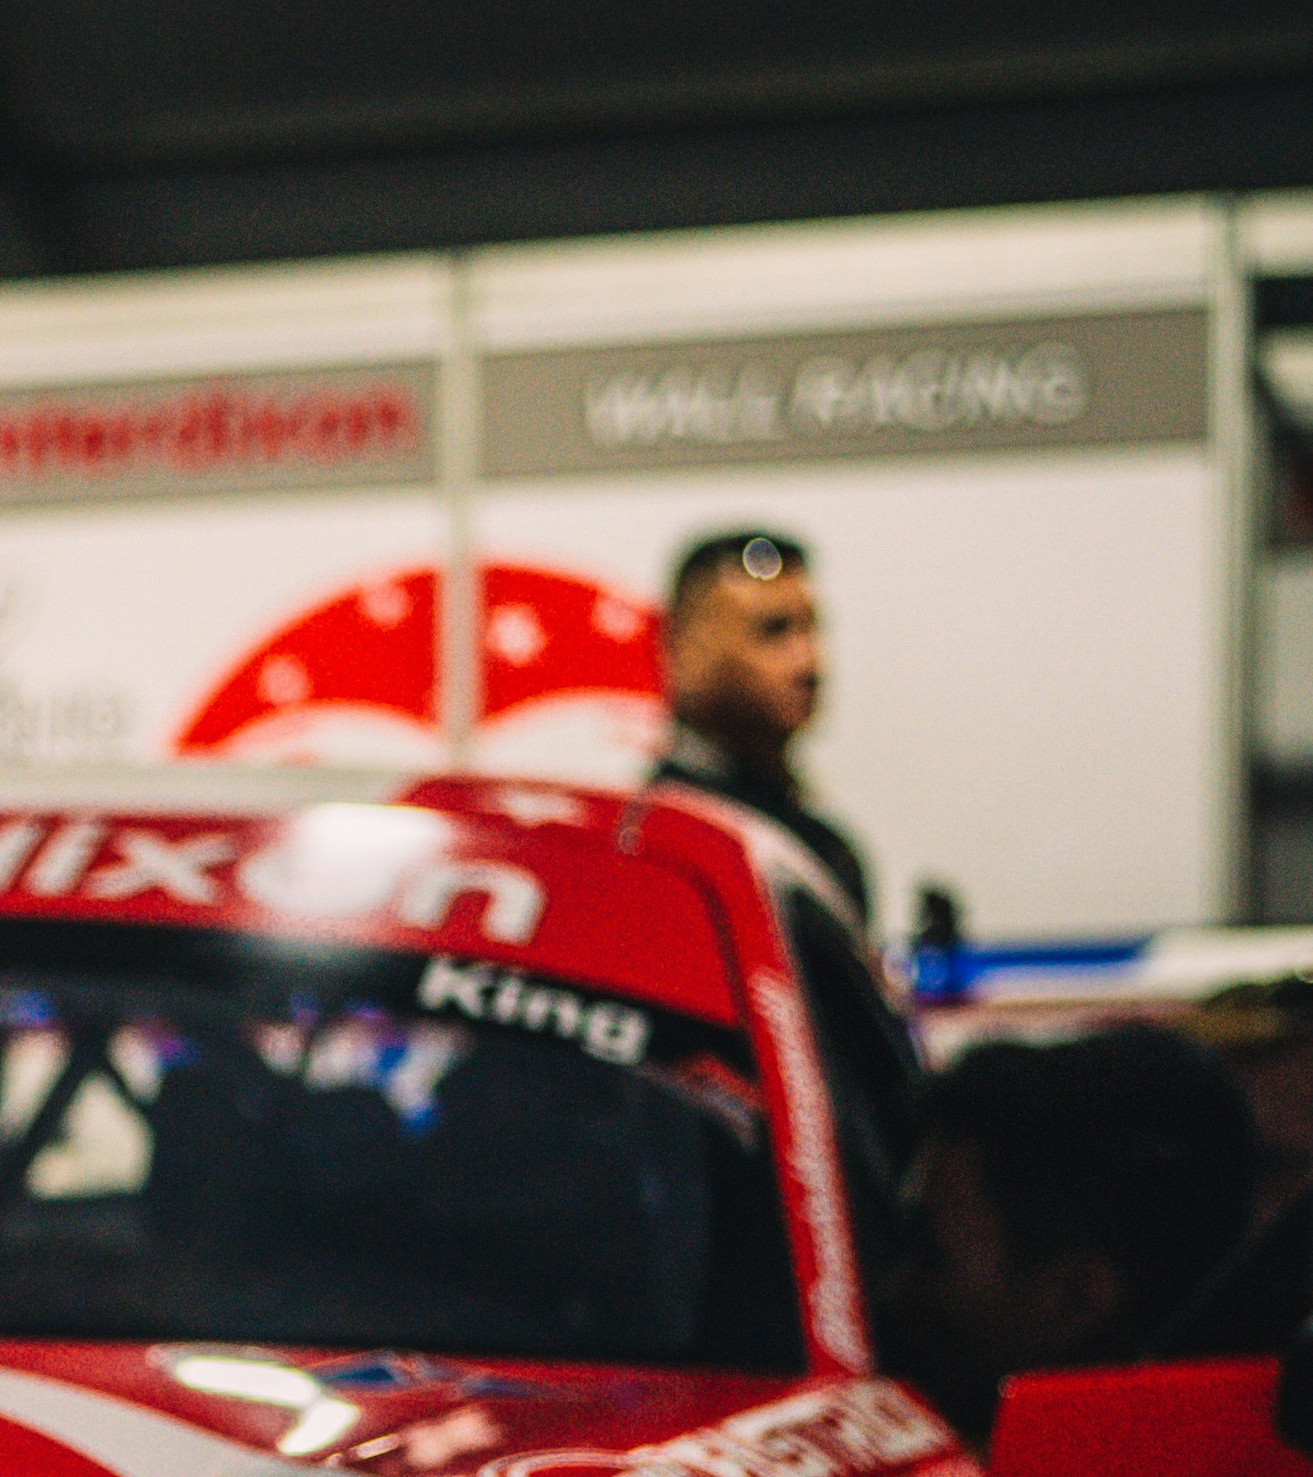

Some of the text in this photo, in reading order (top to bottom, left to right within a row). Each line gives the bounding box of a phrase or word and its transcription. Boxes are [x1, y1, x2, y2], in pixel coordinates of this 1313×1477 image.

[584, 341, 1087, 448] WALL RACING
[417, 955, 653, 1069] King
